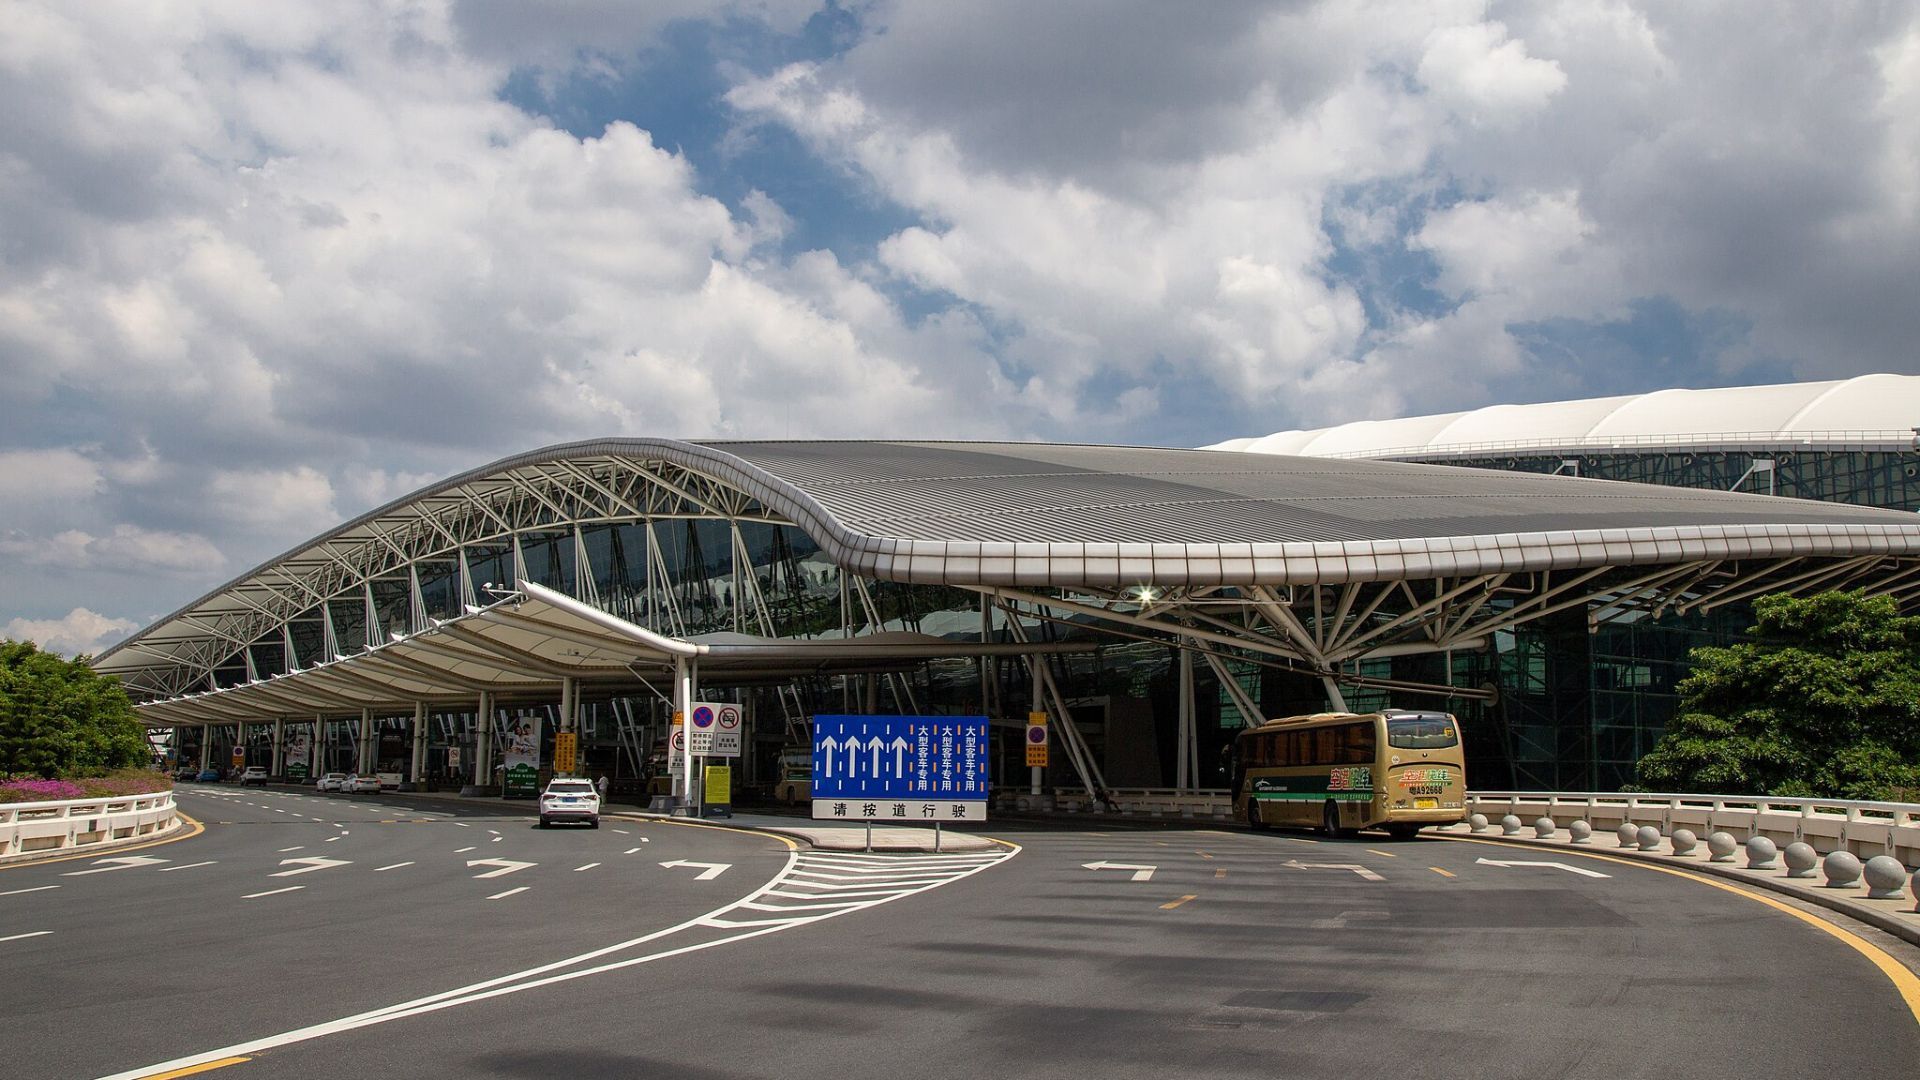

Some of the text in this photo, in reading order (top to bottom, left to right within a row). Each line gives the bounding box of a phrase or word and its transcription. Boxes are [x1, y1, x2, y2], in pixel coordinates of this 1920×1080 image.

[917, 725, 929, 791] 大型客车专用
[941, 725, 953, 792] 大型客车专用
[965, 725, 976, 792] 大型客车专用
[833, 802, 966, 818] 请按道行驶
